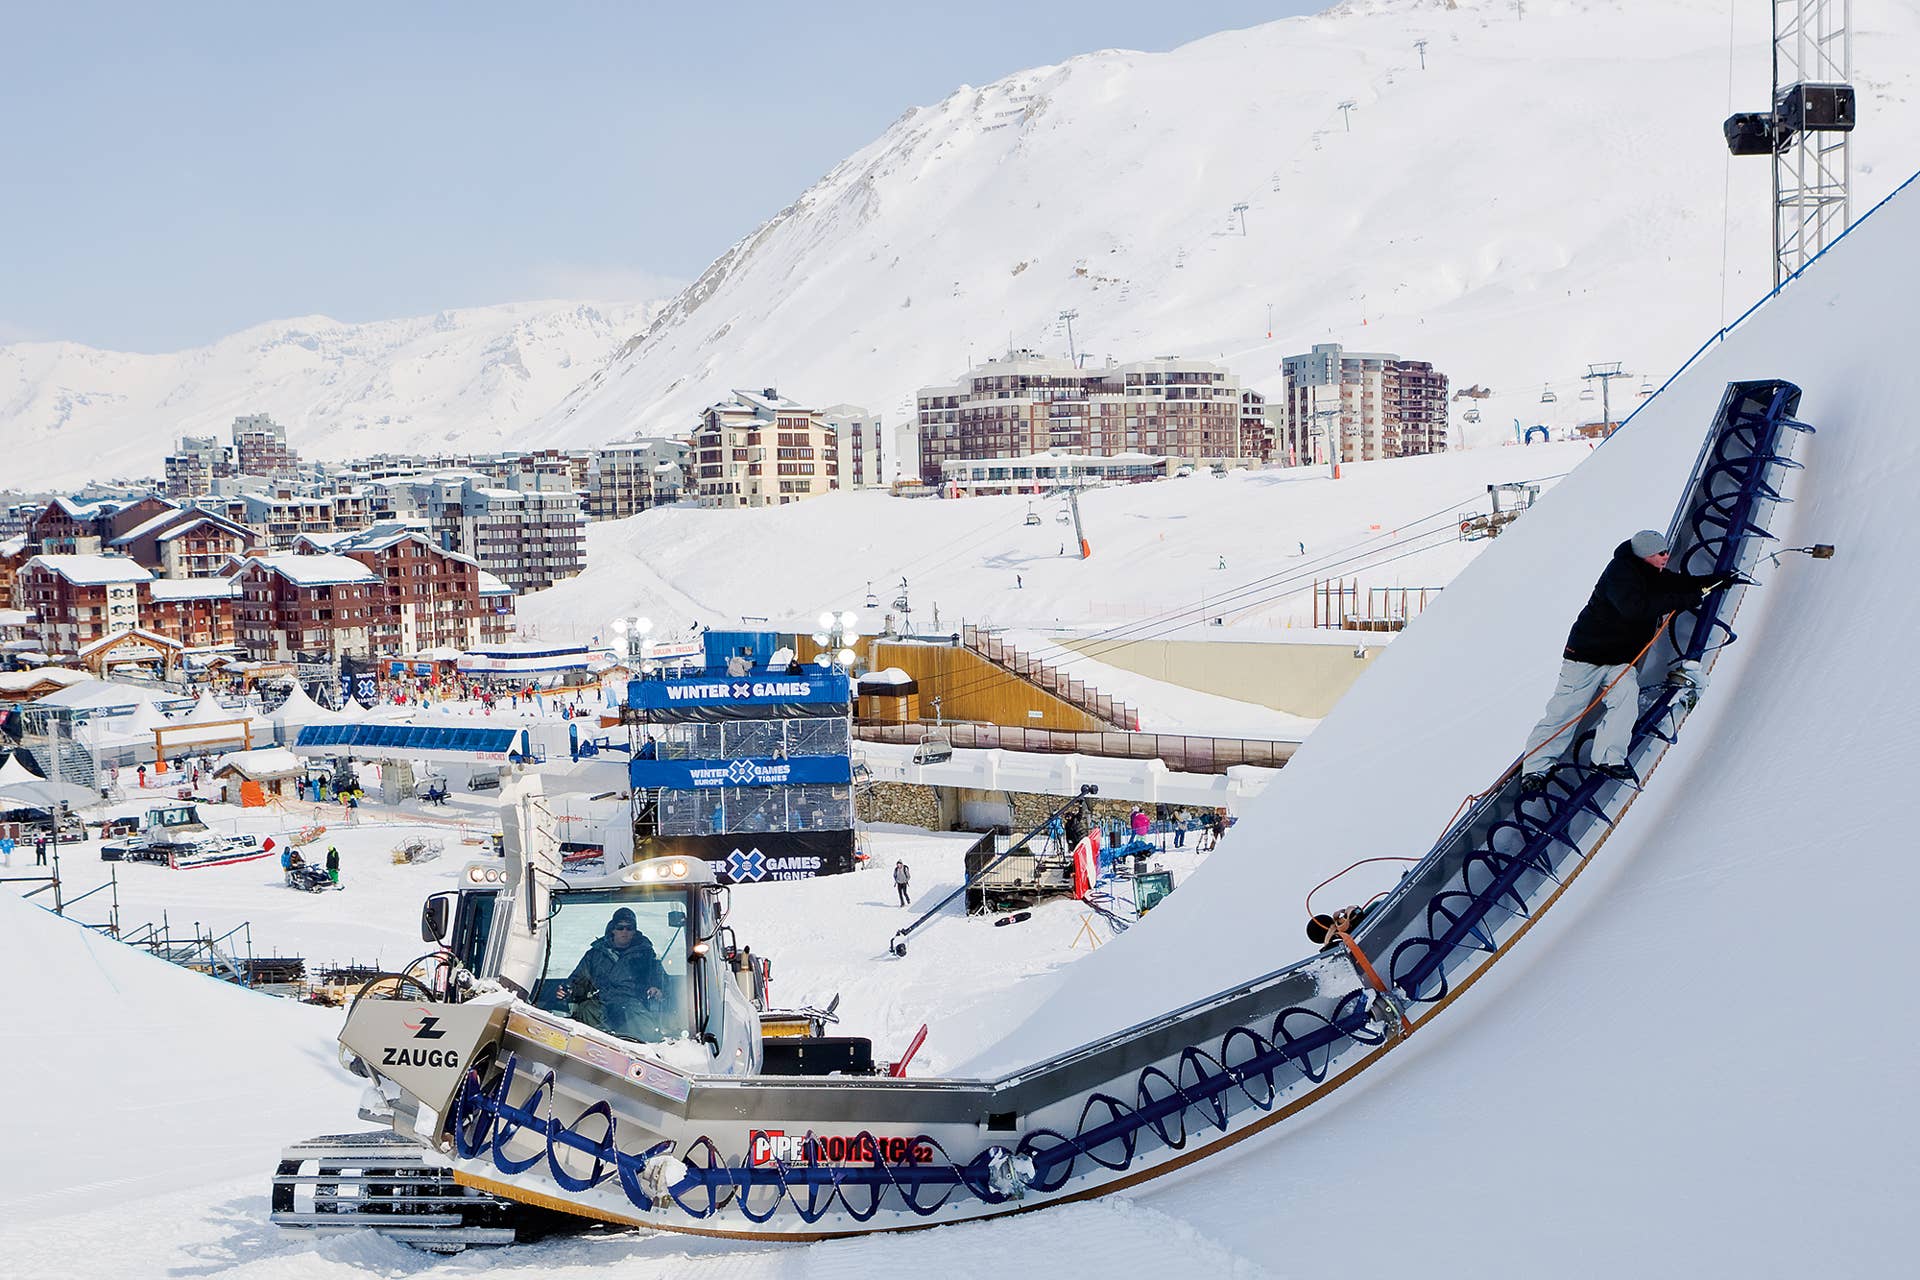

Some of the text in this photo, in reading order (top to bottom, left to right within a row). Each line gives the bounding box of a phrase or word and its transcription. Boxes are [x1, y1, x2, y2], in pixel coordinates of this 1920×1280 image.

[666, 684, 731, 700] WINTER
[752, 682, 811, 697] GAMES
[689, 768, 730, 779] WINTER
[754, 764, 791, 775] GAMES
[694, 774, 788, 786] EUROPE TIGNES
[765, 856, 822, 871] GAMES
[771, 871, 816, 881] TIGNES
[382, 1047, 459, 1068] ZAUGG
